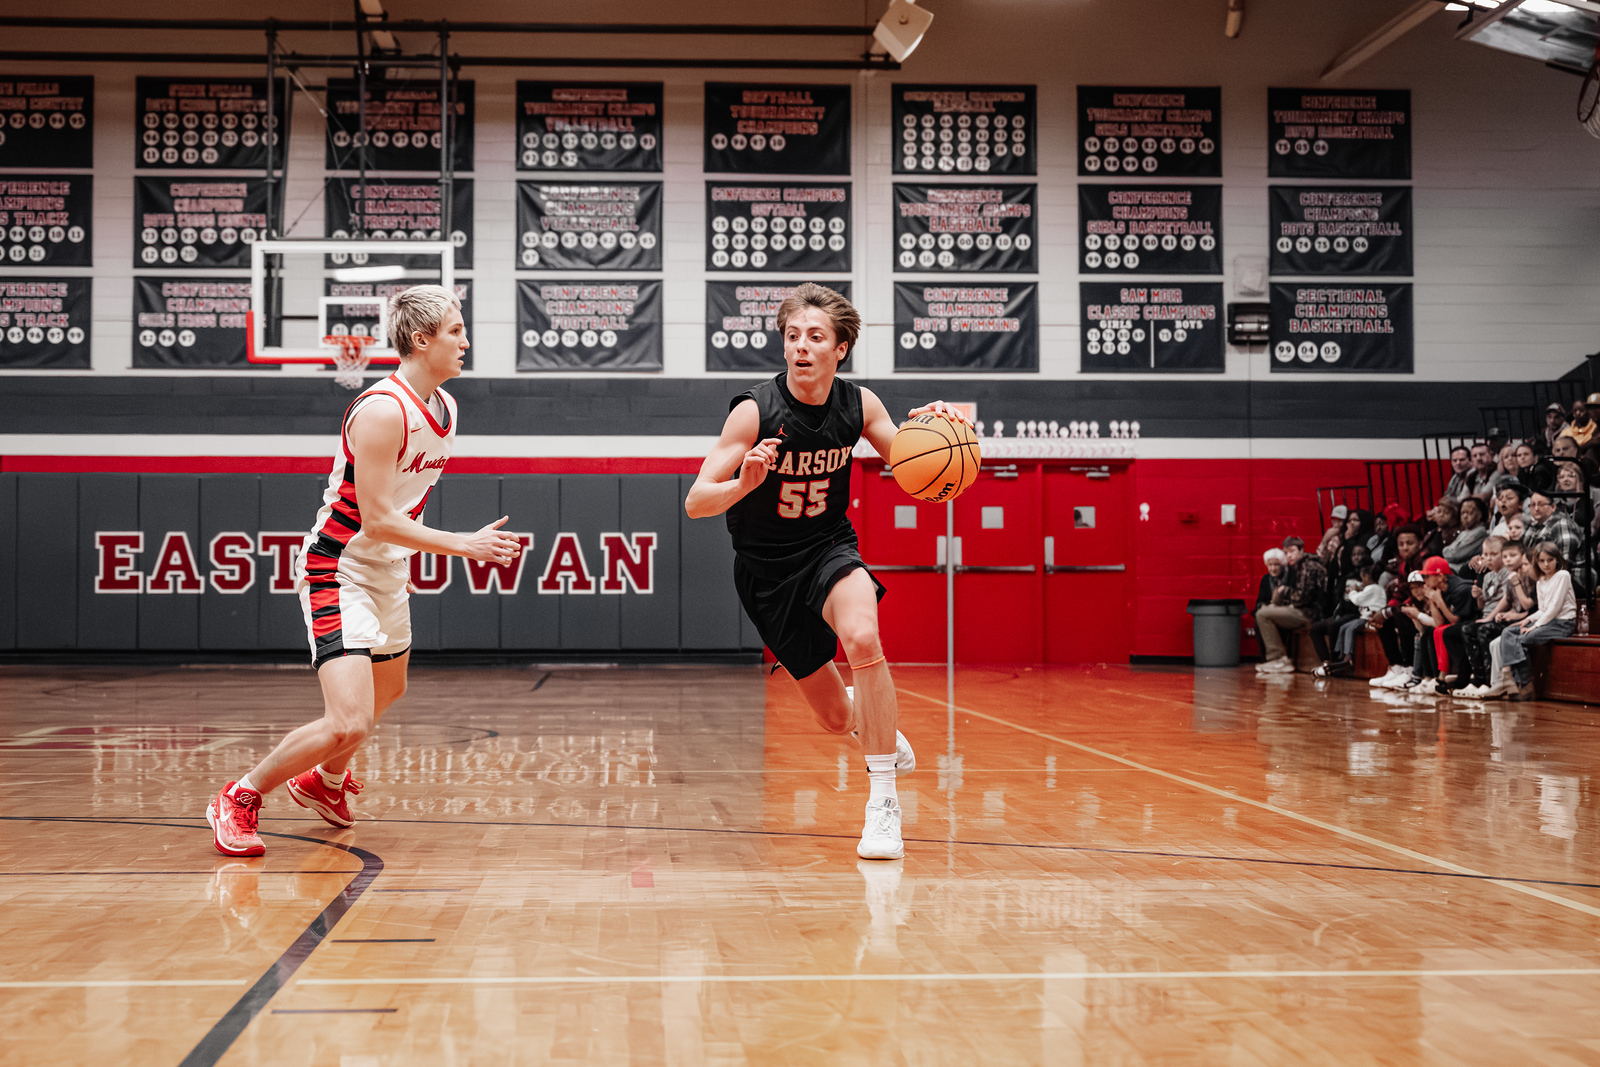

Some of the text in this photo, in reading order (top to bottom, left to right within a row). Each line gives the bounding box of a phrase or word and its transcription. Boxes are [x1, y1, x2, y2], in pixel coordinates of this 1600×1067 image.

[0, 181, 70, 195] FERENCE
[711, 187, 846, 202] CONFERENCE CHAMPIONS
[0, 197, 64, 210] MPIONS
[1108, 191, 1192, 204] CONFERENCE
[1300, 192, 1382, 206] CONFERENCE
[900, 203, 1031, 217] TOURNAMENT CHAMPS
[1112, 206, 1188, 219] CHAMPIONS
[1304, 207, 1379, 221] CHAMPIONS
[13, 212, 69, 226] TRACK
[540, 217, 639, 231] VOLLEYBALL
[929, 217, 1002, 233] BASEBALL
[1087, 221, 1213, 235] GIRLS BASKETBALL
[1281, 222, 1402, 236] BOYS BASKETBALL
[0, 282, 68, 297] FERENCE
[540, 285, 639, 300] CONFERENCE
[736, 286, 799, 301] CONFERE
[924, 287, 1009, 302] CONFERENCE
[1120, 288, 1183, 303] SAM MOIR
[1296, 288, 1386, 303] SECTIONAL
[0, 298, 63, 312] MPIONS
[546, 300, 634, 315] CHAMPIONS
[928, 303, 1004, 317] CHAMPIONS
[1087, 304, 1216, 320] CLASSIC CHAMPIONS
[1295, 304, 1388, 318] CHAMPIONS
[14, 313, 69, 327] TRACK
[550, 315, 629, 330] FOOTBALL
[723, 316, 762, 331] GIRLS
[913, 317, 1020, 332] BOYS SWIMMING
[1289, 319, 1394, 333] BASKETBALL
[1278, 345, 1291, 353] 99
[777, 478, 830, 519] 55
[95, 531, 657, 594] EAST OWAN
